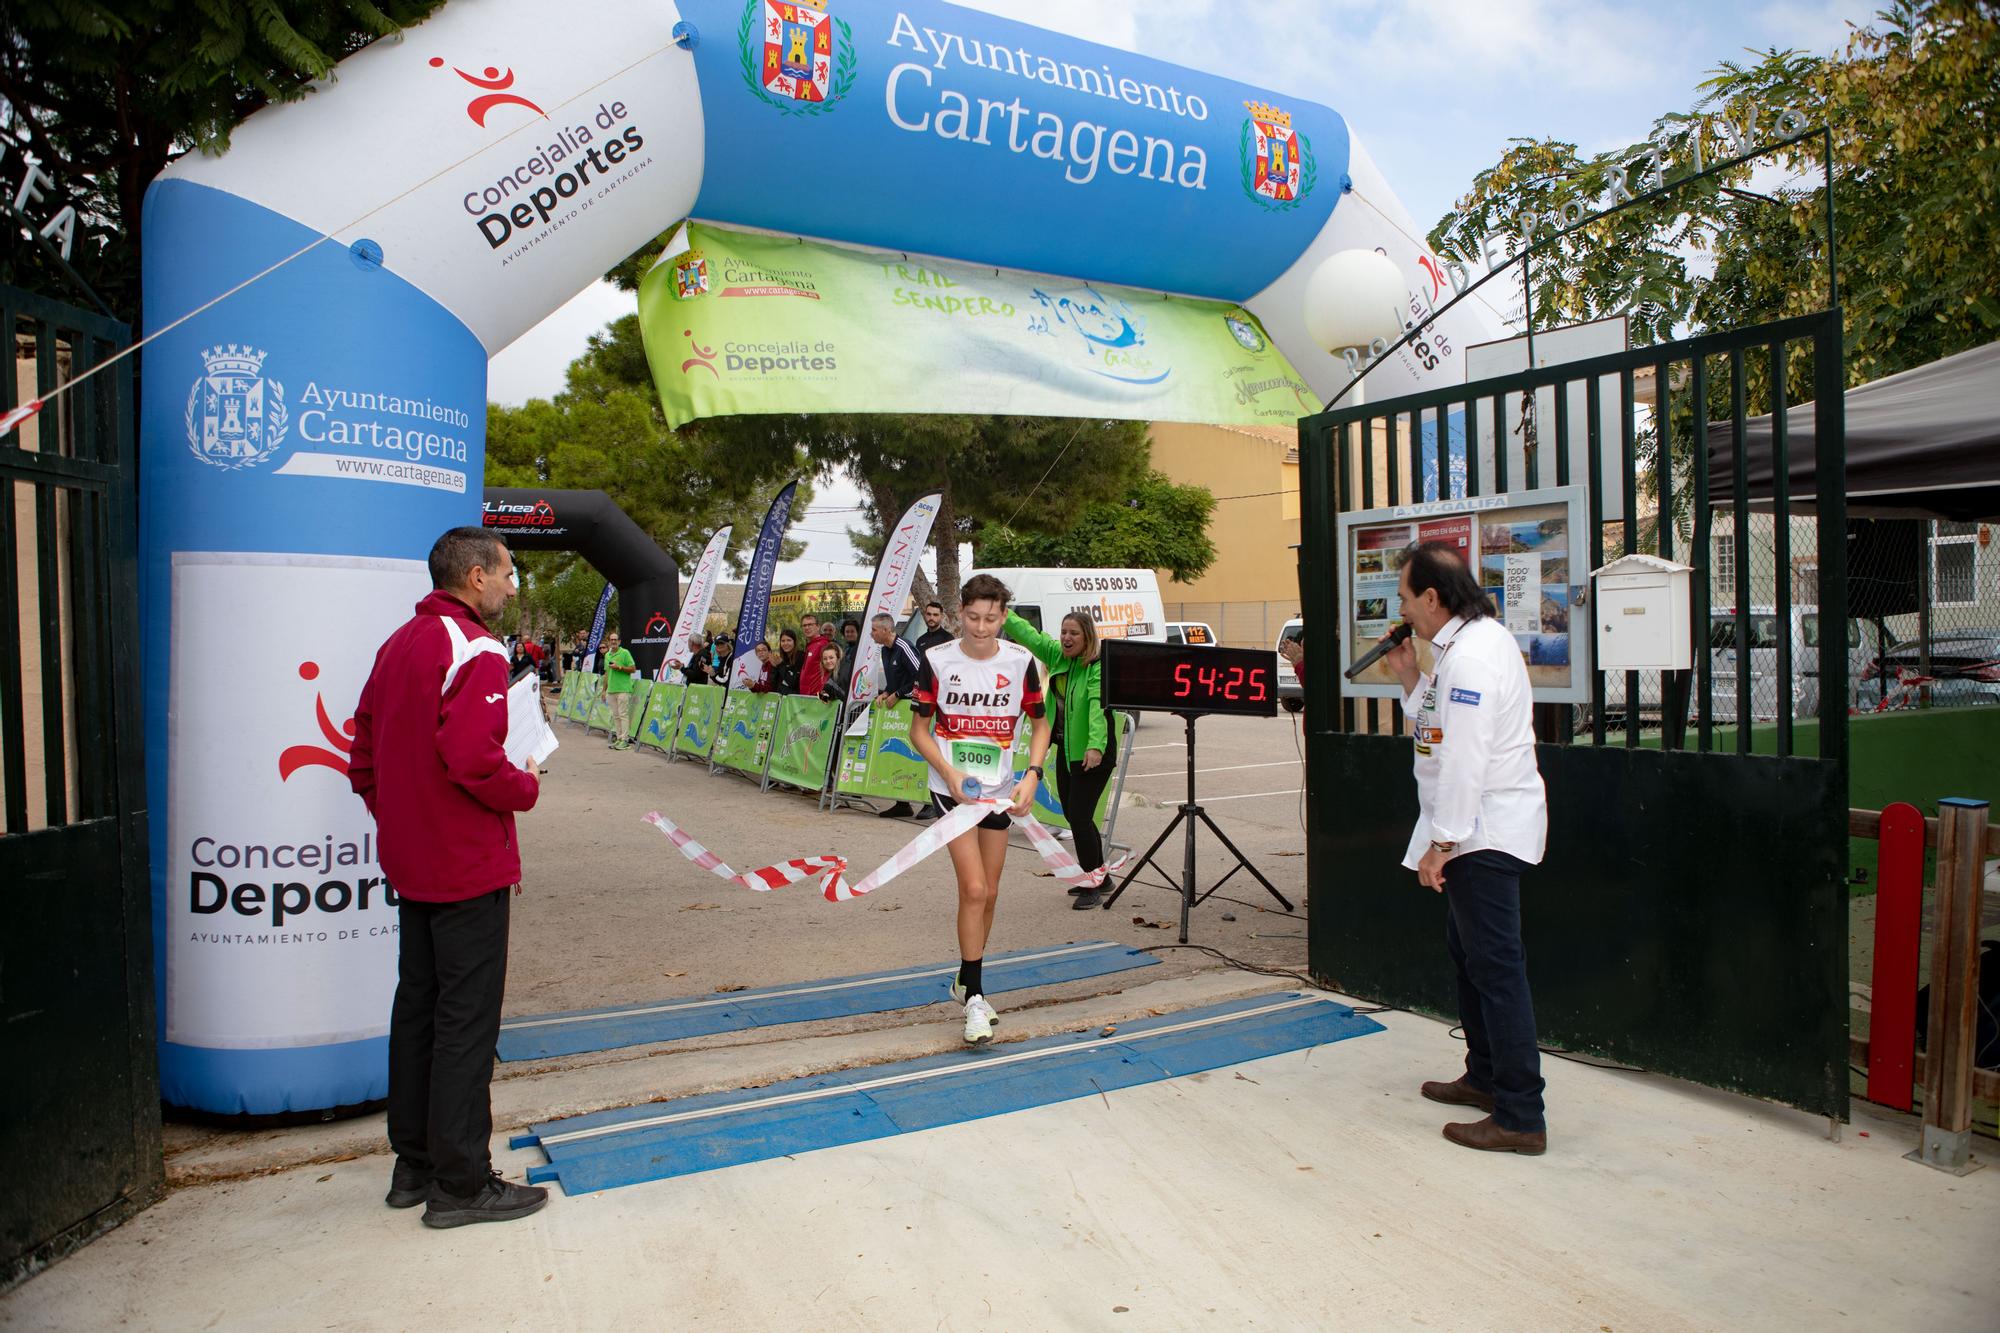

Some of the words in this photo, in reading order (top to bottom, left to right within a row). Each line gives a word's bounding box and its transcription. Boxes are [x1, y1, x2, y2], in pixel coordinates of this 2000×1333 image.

[887, 12, 1208, 121] Ayuntamiento
[886, 62, 1207, 190] Cartagena
[464, 126, 593, 216] Concejalía
[595, 101, 628, 130] de
[476, 126, 644, 250] Deportes
[502, 211, 578, 267] AYUNTAMIENTO
[581, 200, 595, 210] DE
[597, 157, 653, 199] CARTAGENA
[892, 288, 1016, 317] SENDERO
[726, 354, 837, 374] Deportes
[814, 340, 835, 352] de
[1434, 333, 1452, 357] de
[300, 382, 469, 429] Ayuntamiento
[299, 410, 468, 463] Cartagena
[336, 459, 464, 488] www.cartagena.es
[1421, 528, 1440, 537] TEATRO
[1448, 525, 1471, 534] GALIFA
[674, 549, 715, 656] CARTAGENA
[744, 538, 775, 646] Cartagena
[1073, 577, 1094, 591] 605
[1095, 578, 1109, 591] 50
[1110, 578, 1124, 591] 80
[1125, 577, 1138, 590] 50
[1188, 627, 1204, 636] 112
[946, 692, 1010, 707] DAPLES
[1174, 663, 1266, 701] 54:25
[959, 752, 992, 765] 3009
[191, 834, 379, 875] Concejal
[190, 871, 400, 927] Deport
[190, 931, 328, 945] AYUNTAMIENTO
[338, 929, 360, 940] DE
